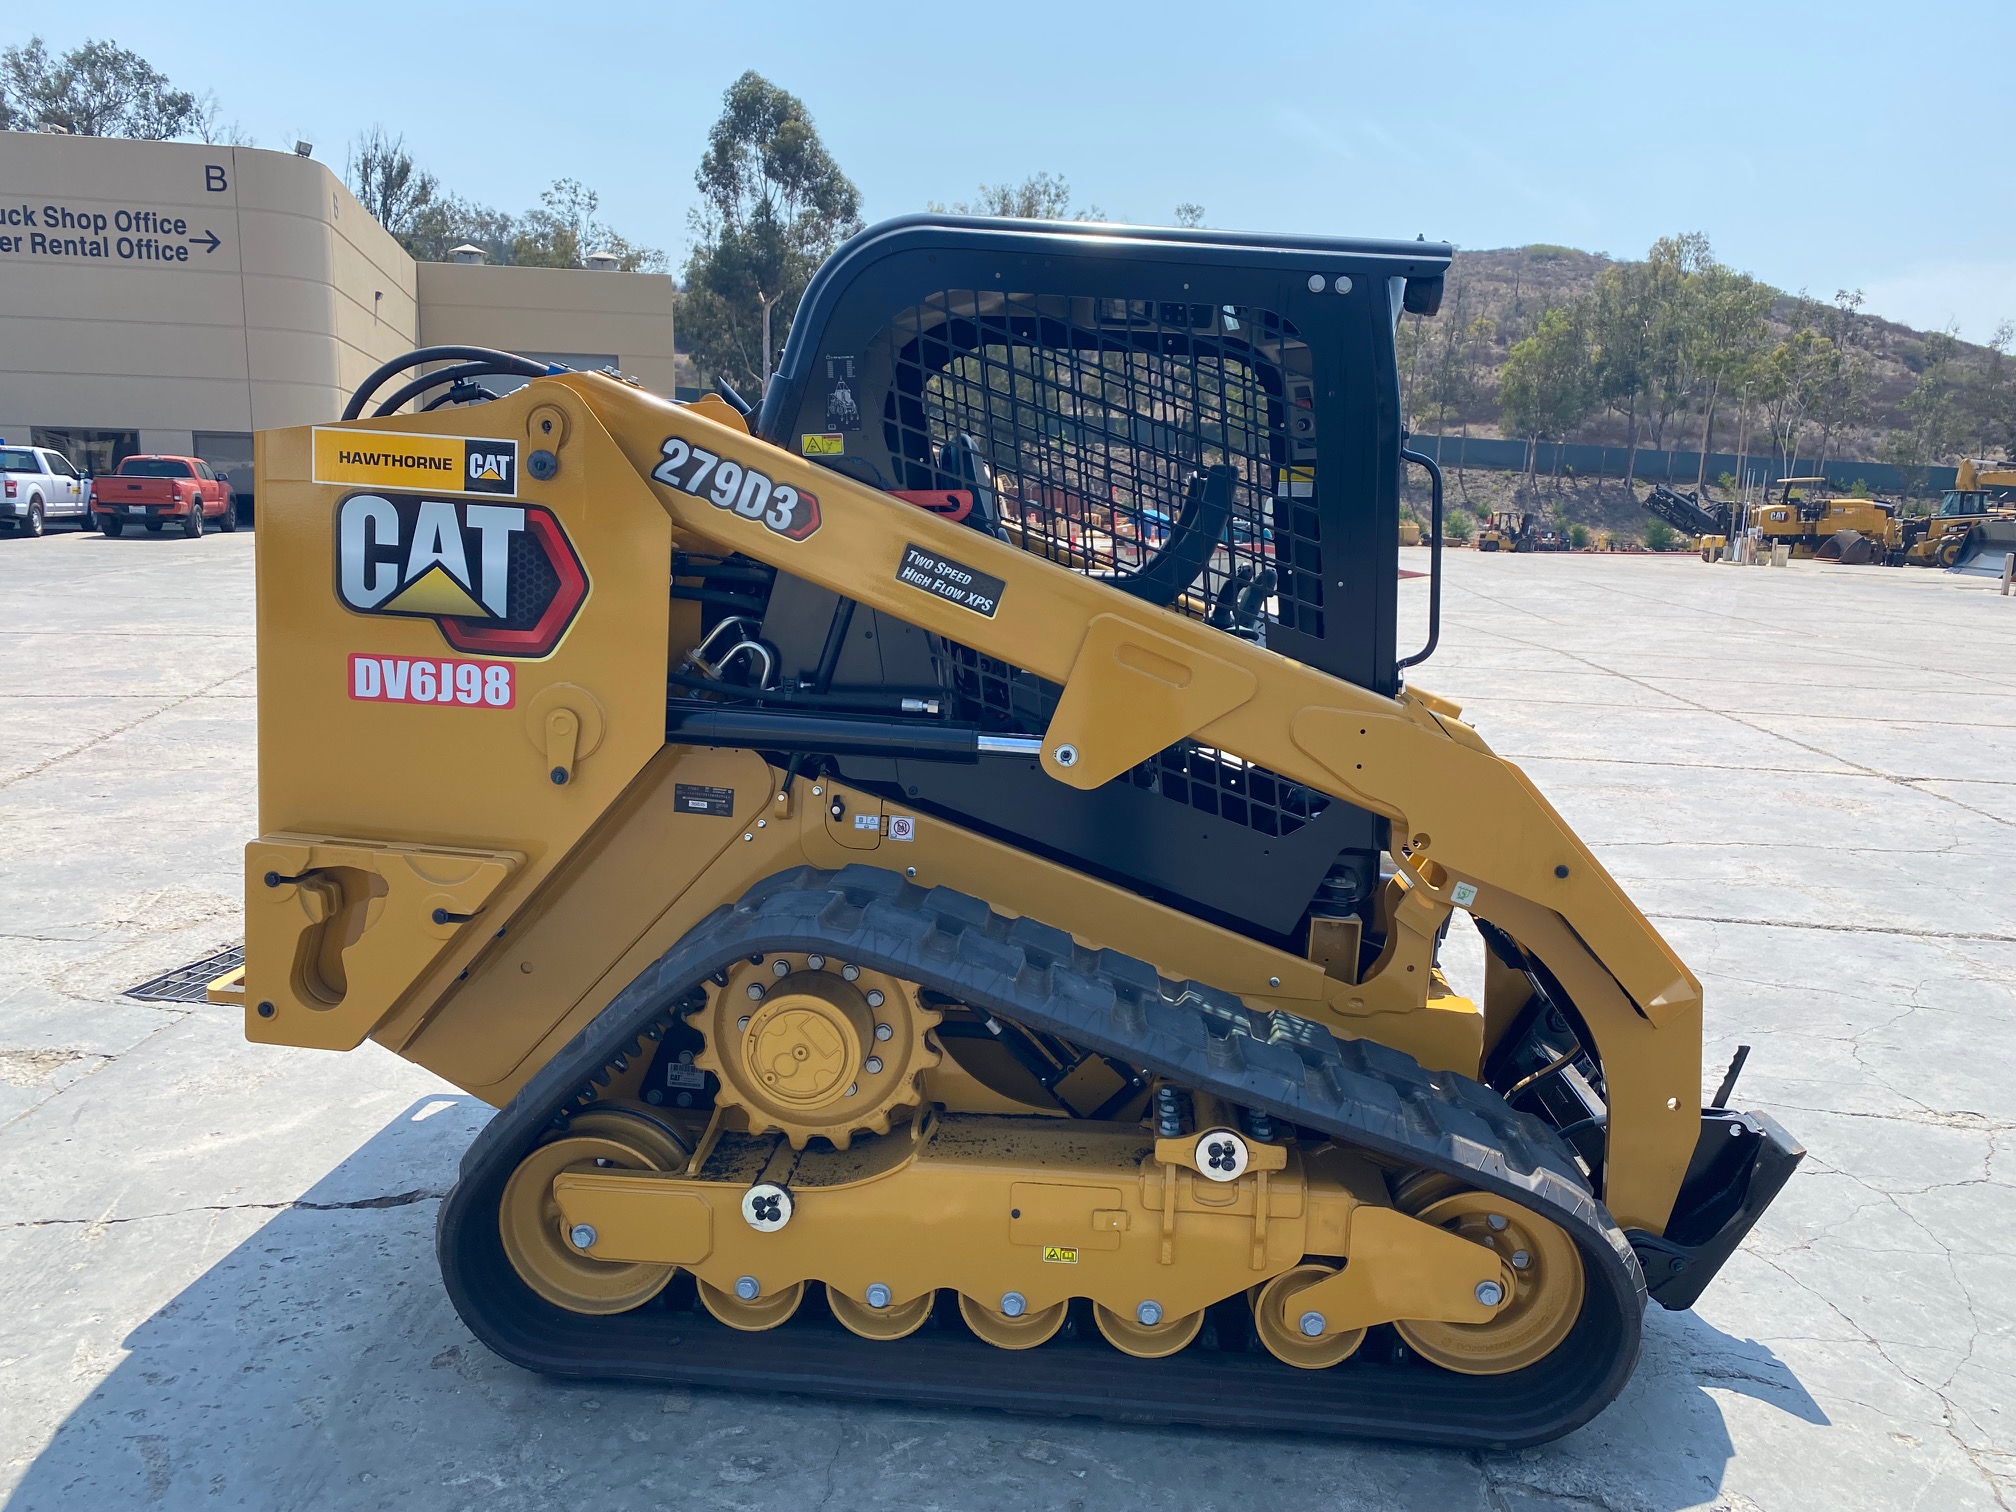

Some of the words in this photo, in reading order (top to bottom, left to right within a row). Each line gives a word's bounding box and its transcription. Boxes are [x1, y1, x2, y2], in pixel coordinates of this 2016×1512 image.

[205, 165, 227, 192] B
[43, 206, 107, 235] Shop
[114, 210, 187, 235] Office
[30, 233, 109, 257] Rental
[116, 237, 188, 262] Office
[339, 450, 452, 470] HAWTHORNE
[469, 453, 510, 480] CAT
[654, 438, 798, 530] 279D3
[1770, 511, 1786, 521] CAT
[341, 495, 525, 618] CAT
[964, 592, 994, 611] XPS
[354, 657, 510, 706] DV6J98
